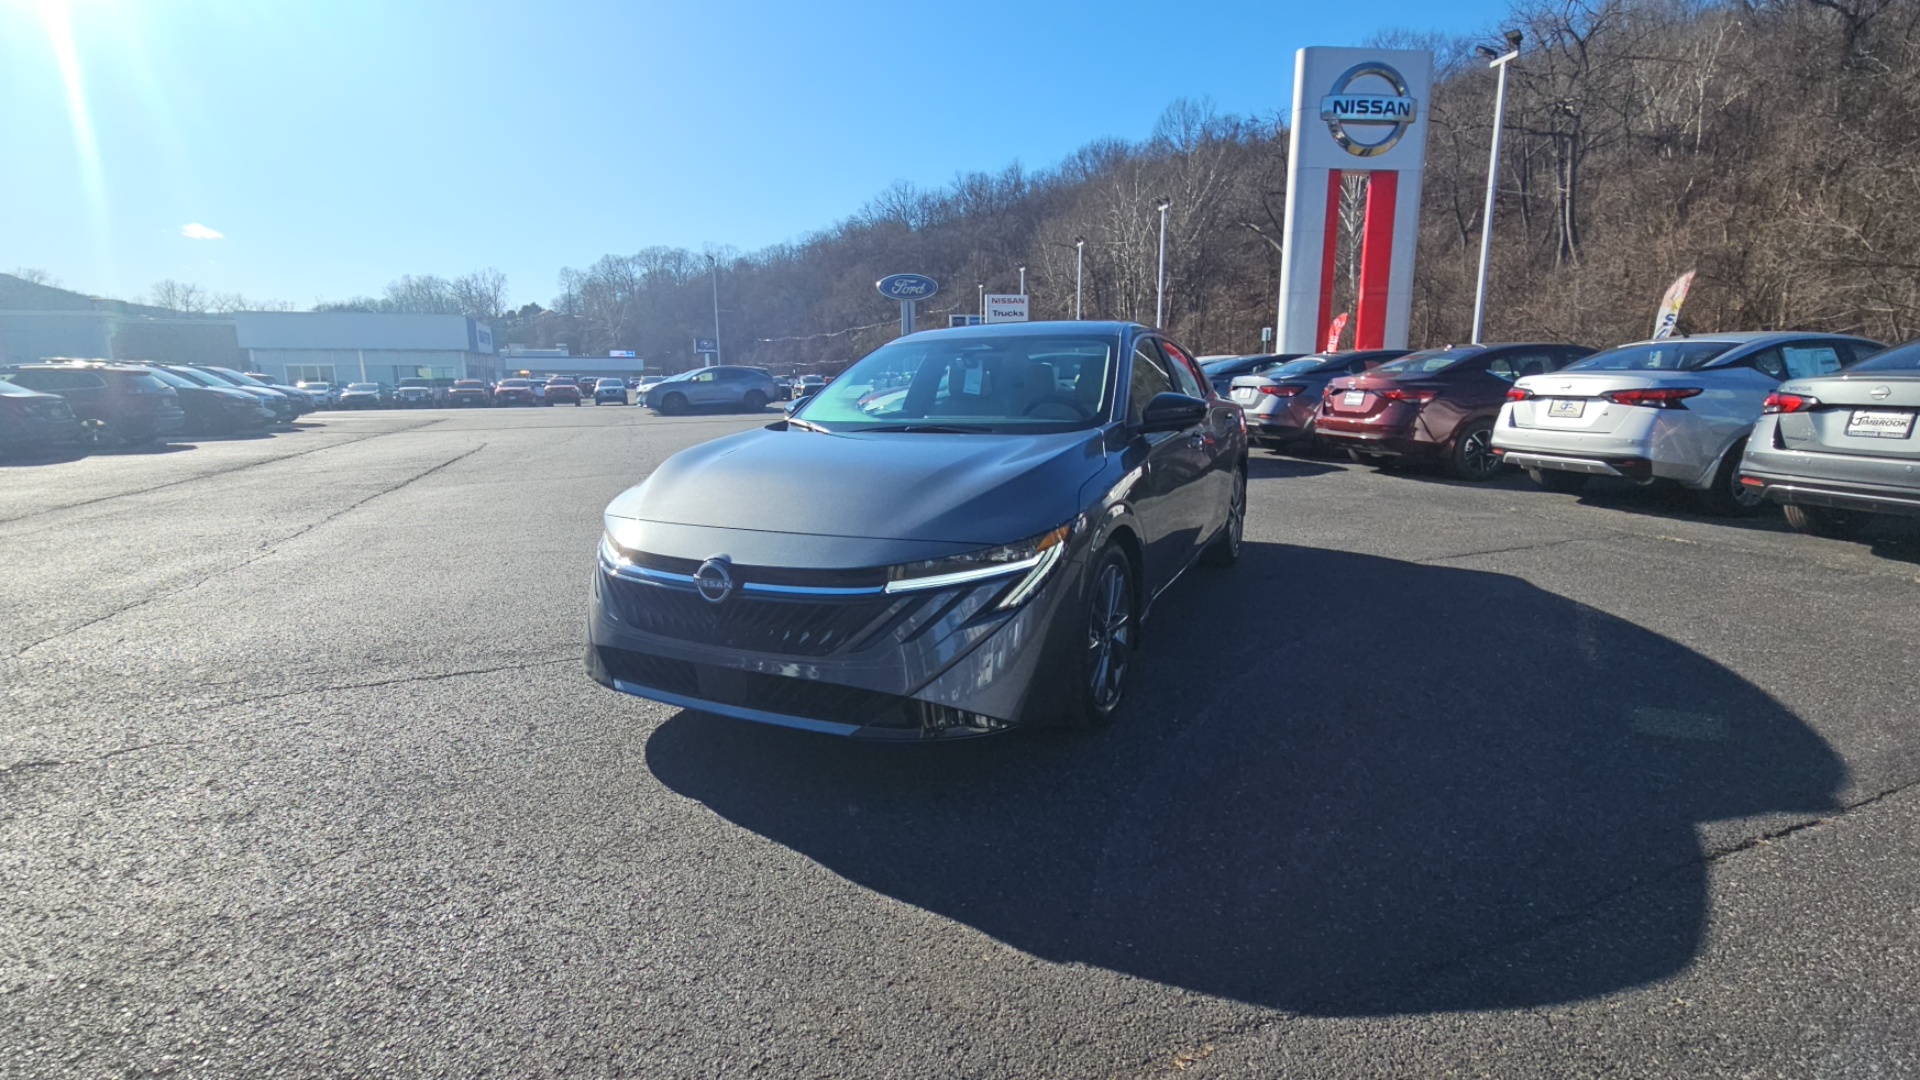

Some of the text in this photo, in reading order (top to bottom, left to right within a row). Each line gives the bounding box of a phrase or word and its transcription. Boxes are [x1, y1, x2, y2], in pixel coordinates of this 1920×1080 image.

[1333, 99, 1410, 116] NISSAN
[891, 278, 926, 294] Ford
[991, 297, 1025, 305] NISSAN
[992, 309, 1024, 317] Trucks
